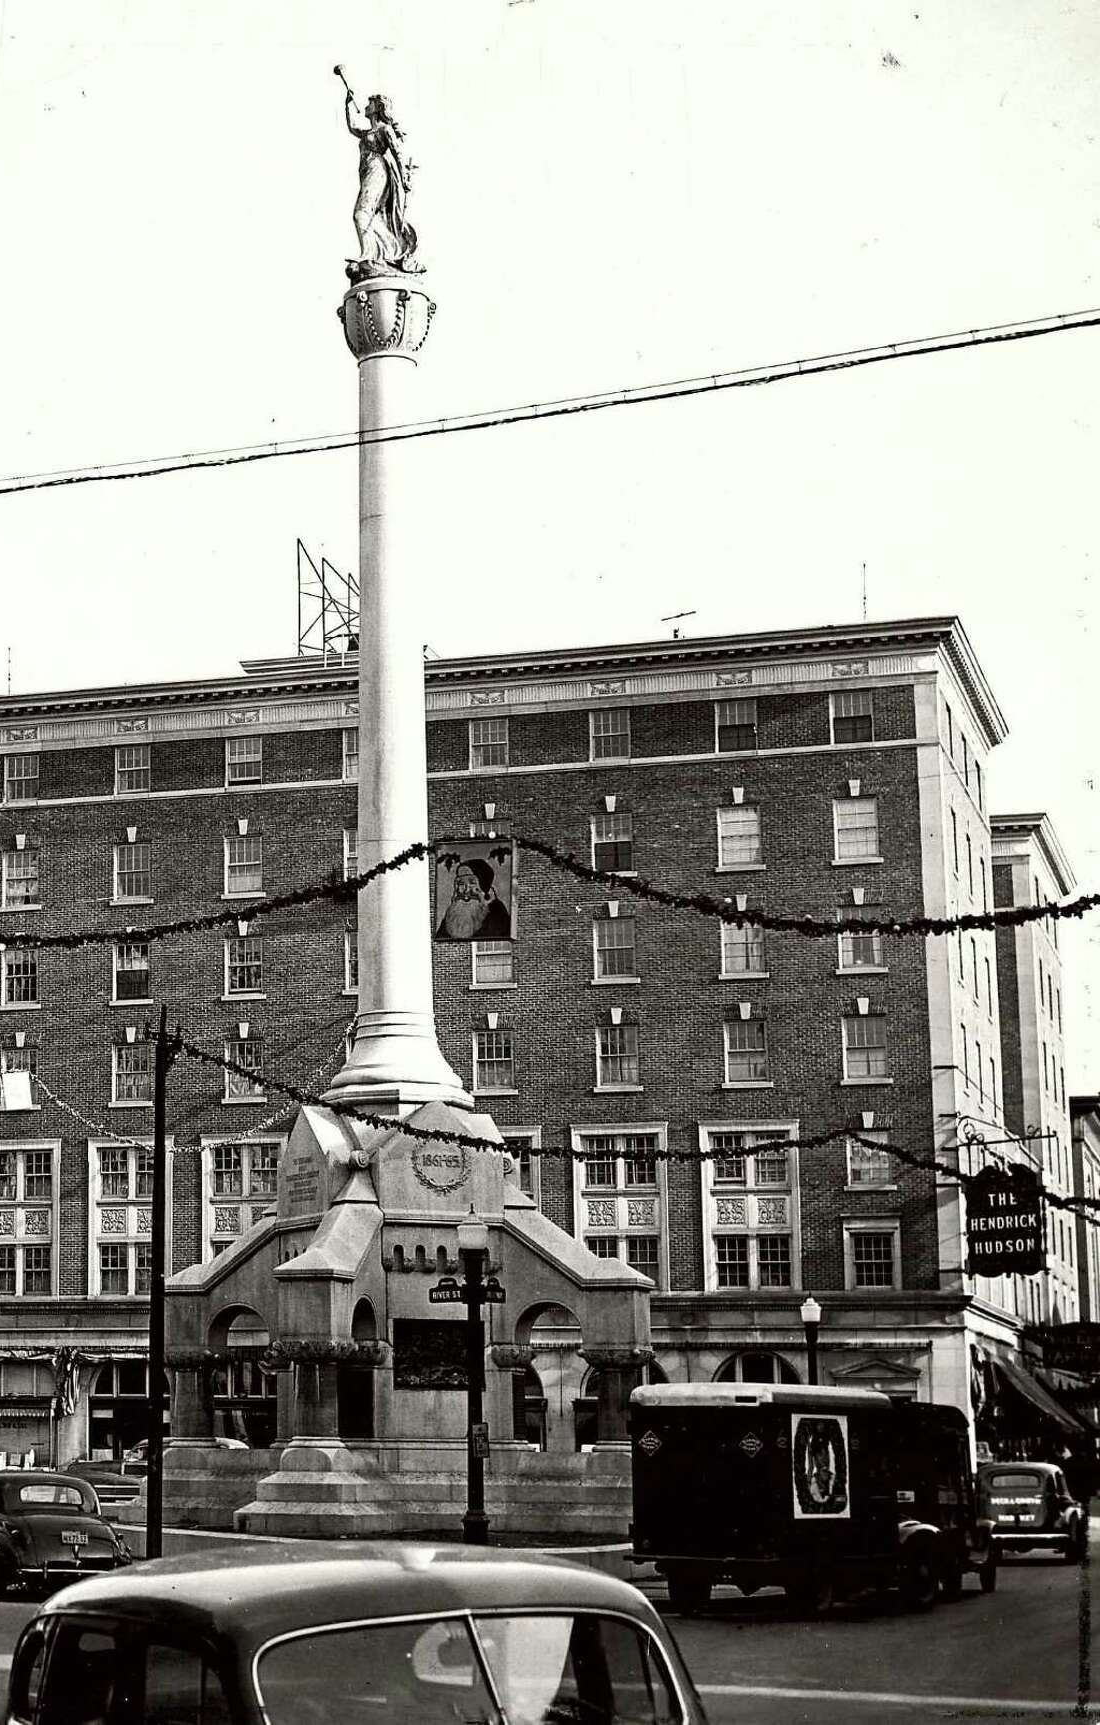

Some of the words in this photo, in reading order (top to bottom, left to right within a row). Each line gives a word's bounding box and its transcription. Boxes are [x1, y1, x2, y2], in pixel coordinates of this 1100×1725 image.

[987, 1192, 1018, 1207] THE
[970, 1213, 1037, 1232] HENDRICK
[974, 1237, 1035, 1255] HUDSON
[432, 1290, 451, 1300] RIVER
